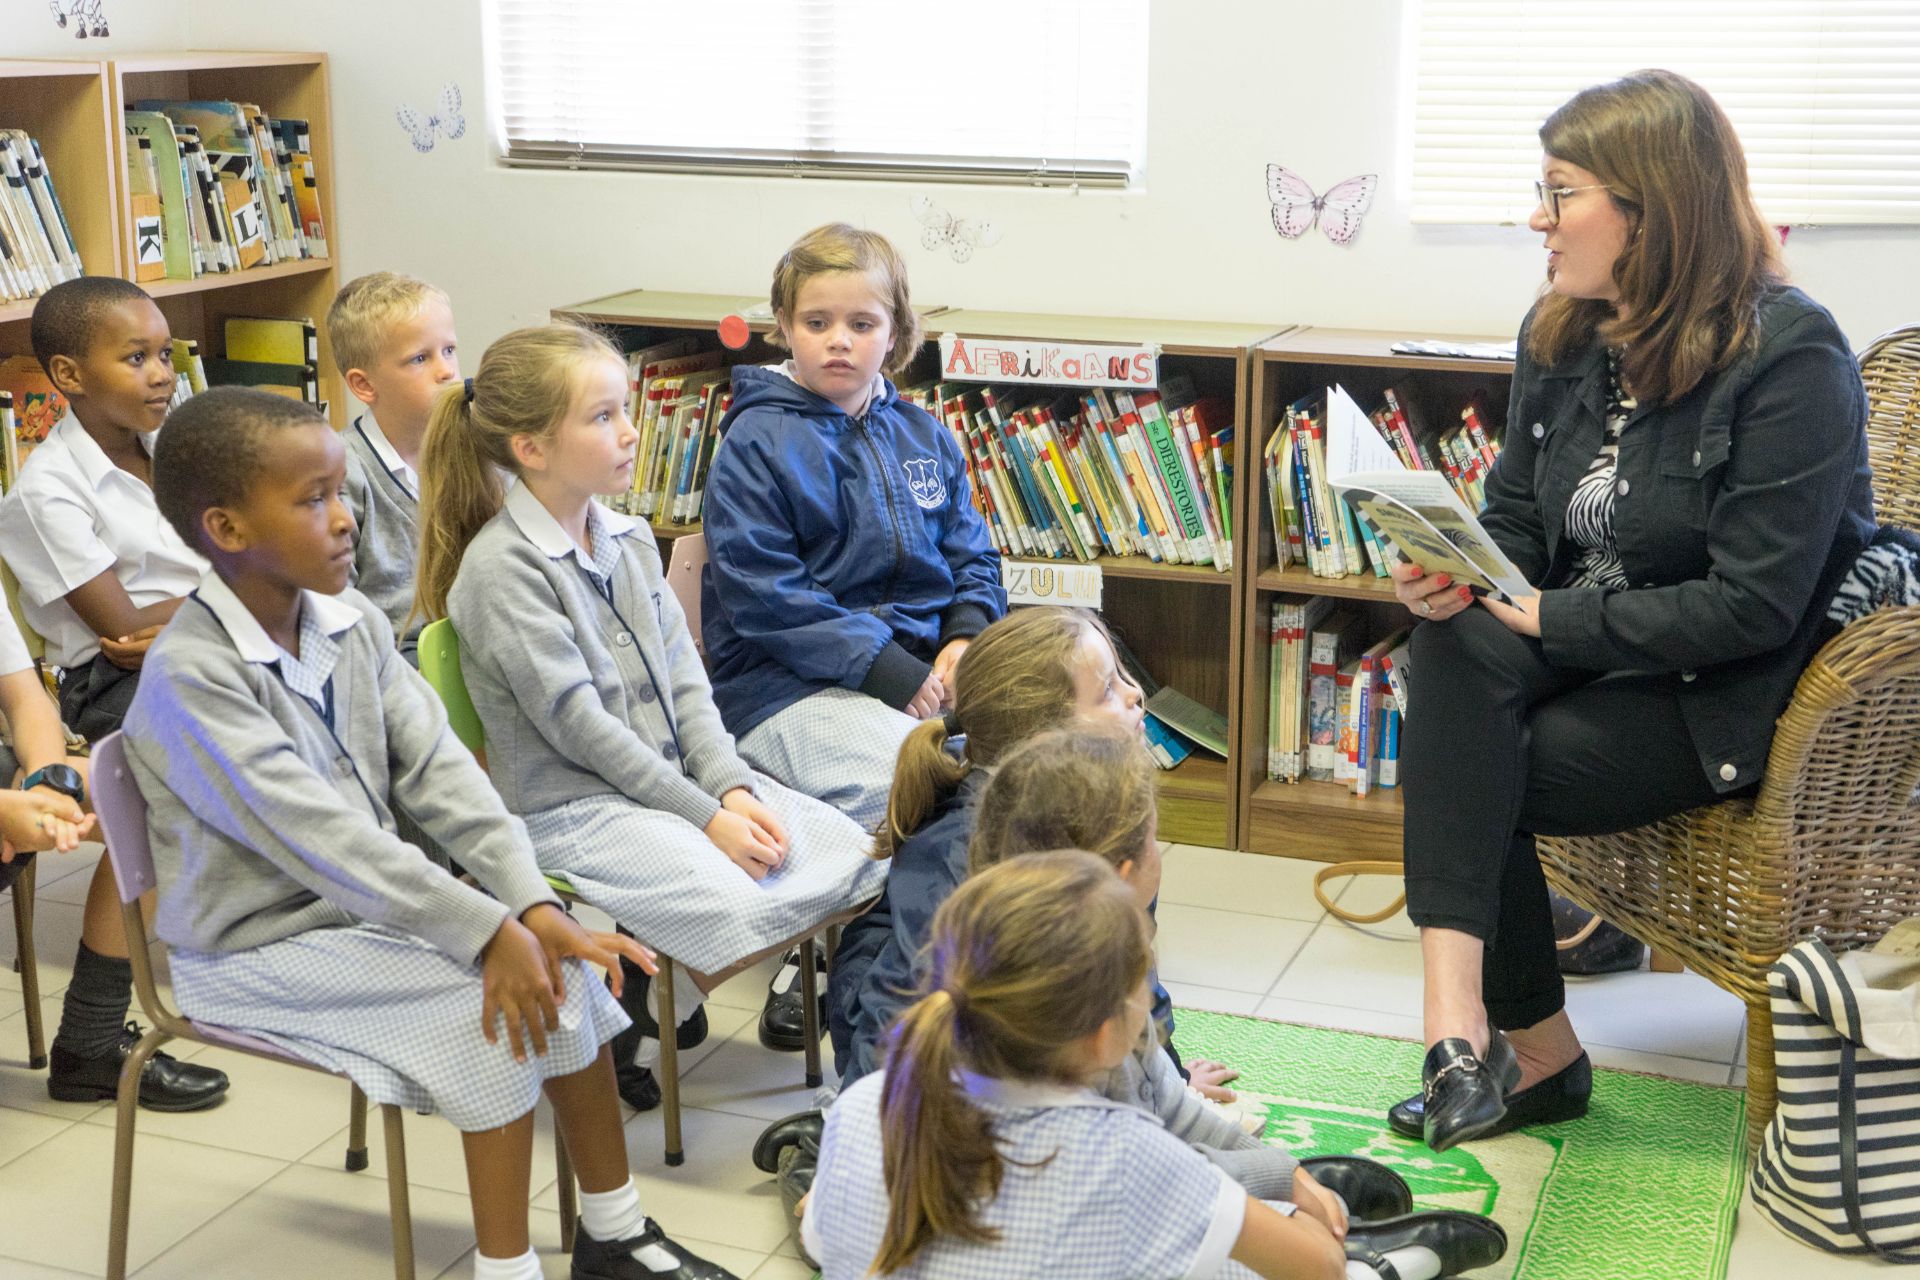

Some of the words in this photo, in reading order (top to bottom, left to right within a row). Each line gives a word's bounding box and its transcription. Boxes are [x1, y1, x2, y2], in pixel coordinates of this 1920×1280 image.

[138, 220, 162, 262] K
[235, 210, 259, 244] L
[1156, 436, 1203, 539] DIERESTORIES
[1008, 567, 1096, 599] ZULU
